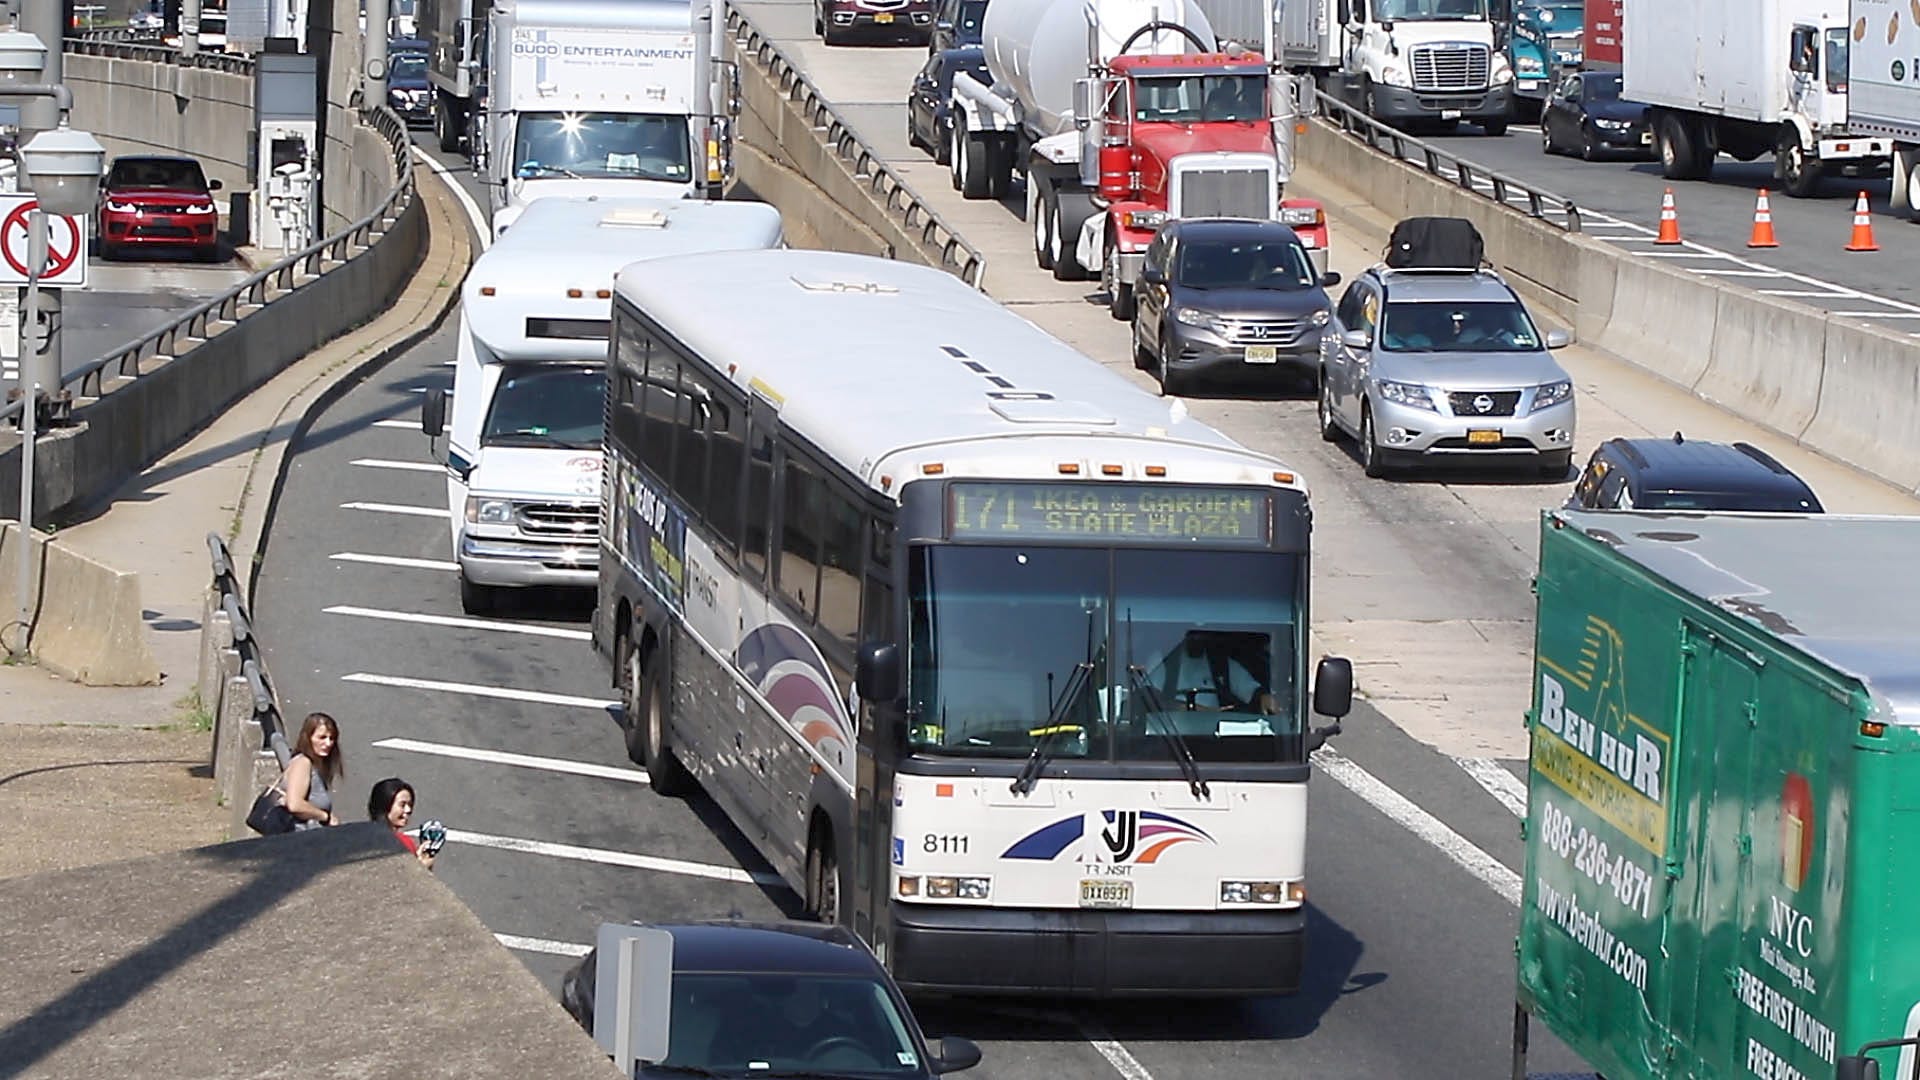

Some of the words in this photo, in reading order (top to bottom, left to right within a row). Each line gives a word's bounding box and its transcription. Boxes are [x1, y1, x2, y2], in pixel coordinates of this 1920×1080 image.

[514, 44, 558, 55] BUDD
[564, 46, 694, 60] ENTERTAINMENT
[953, 490, 1020, 530] 171
[1032, 490, 1100, 511] IKEA
[1138, 490, 1251, 514] GARDEN
[1045, 511, 1138, 534] STATE
[1149, 513, 1242, 536] PLAZA
[924, 834, 967, 853] 8111
[1542, 801, 1653, 919] 888-236-4871
[1085, 864, 1133, 876] TRNSIT
[1537, 877, 1648, 991] www.benhur.com
[1770, 895, 1813, 957] NYC
[1737, 966, 1764, 1013] FREE
[1763, 985, 1794, 1034] FIRST
[1793, 1006, 1836, 1065] MONTH
[1747, 1038, 1775, 1080] FREE
